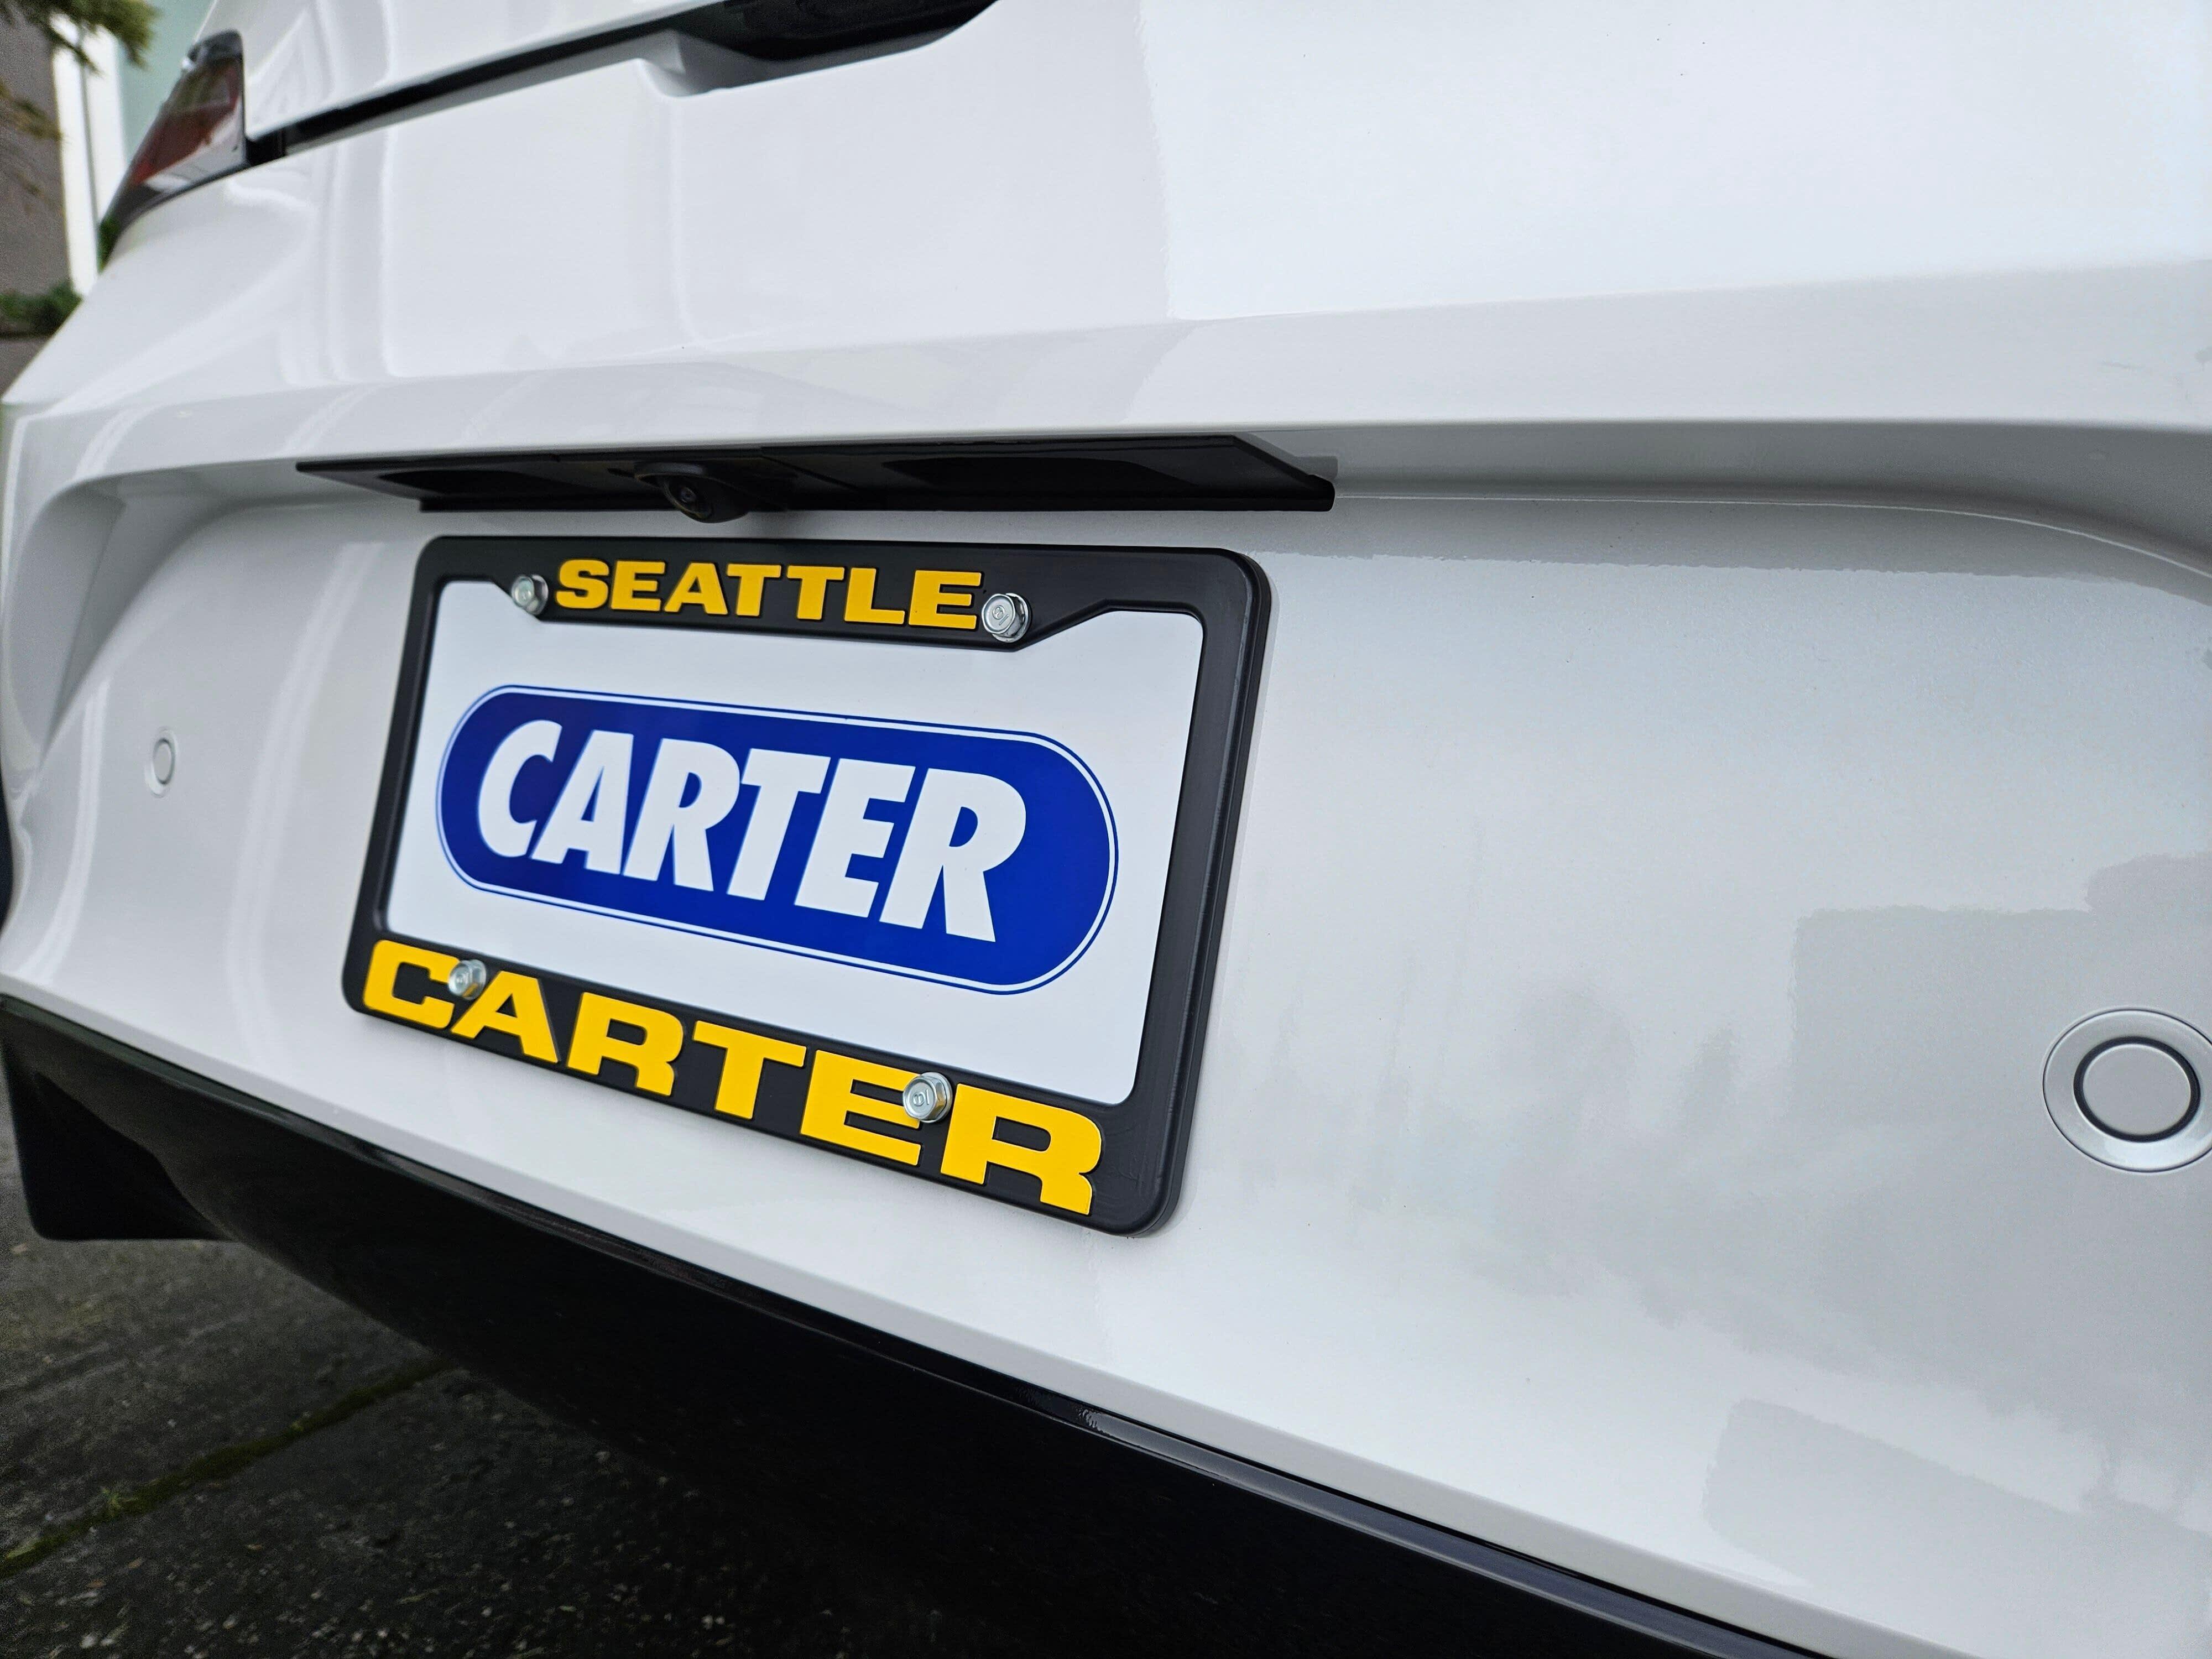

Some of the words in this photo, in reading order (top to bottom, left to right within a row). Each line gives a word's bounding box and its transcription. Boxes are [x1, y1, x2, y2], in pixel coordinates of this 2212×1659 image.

[555, 559, 981, 629] SEATTLE
[478, 720, 1027, 943] CARTER
[362, 940, 1101, 1215] CARTER
